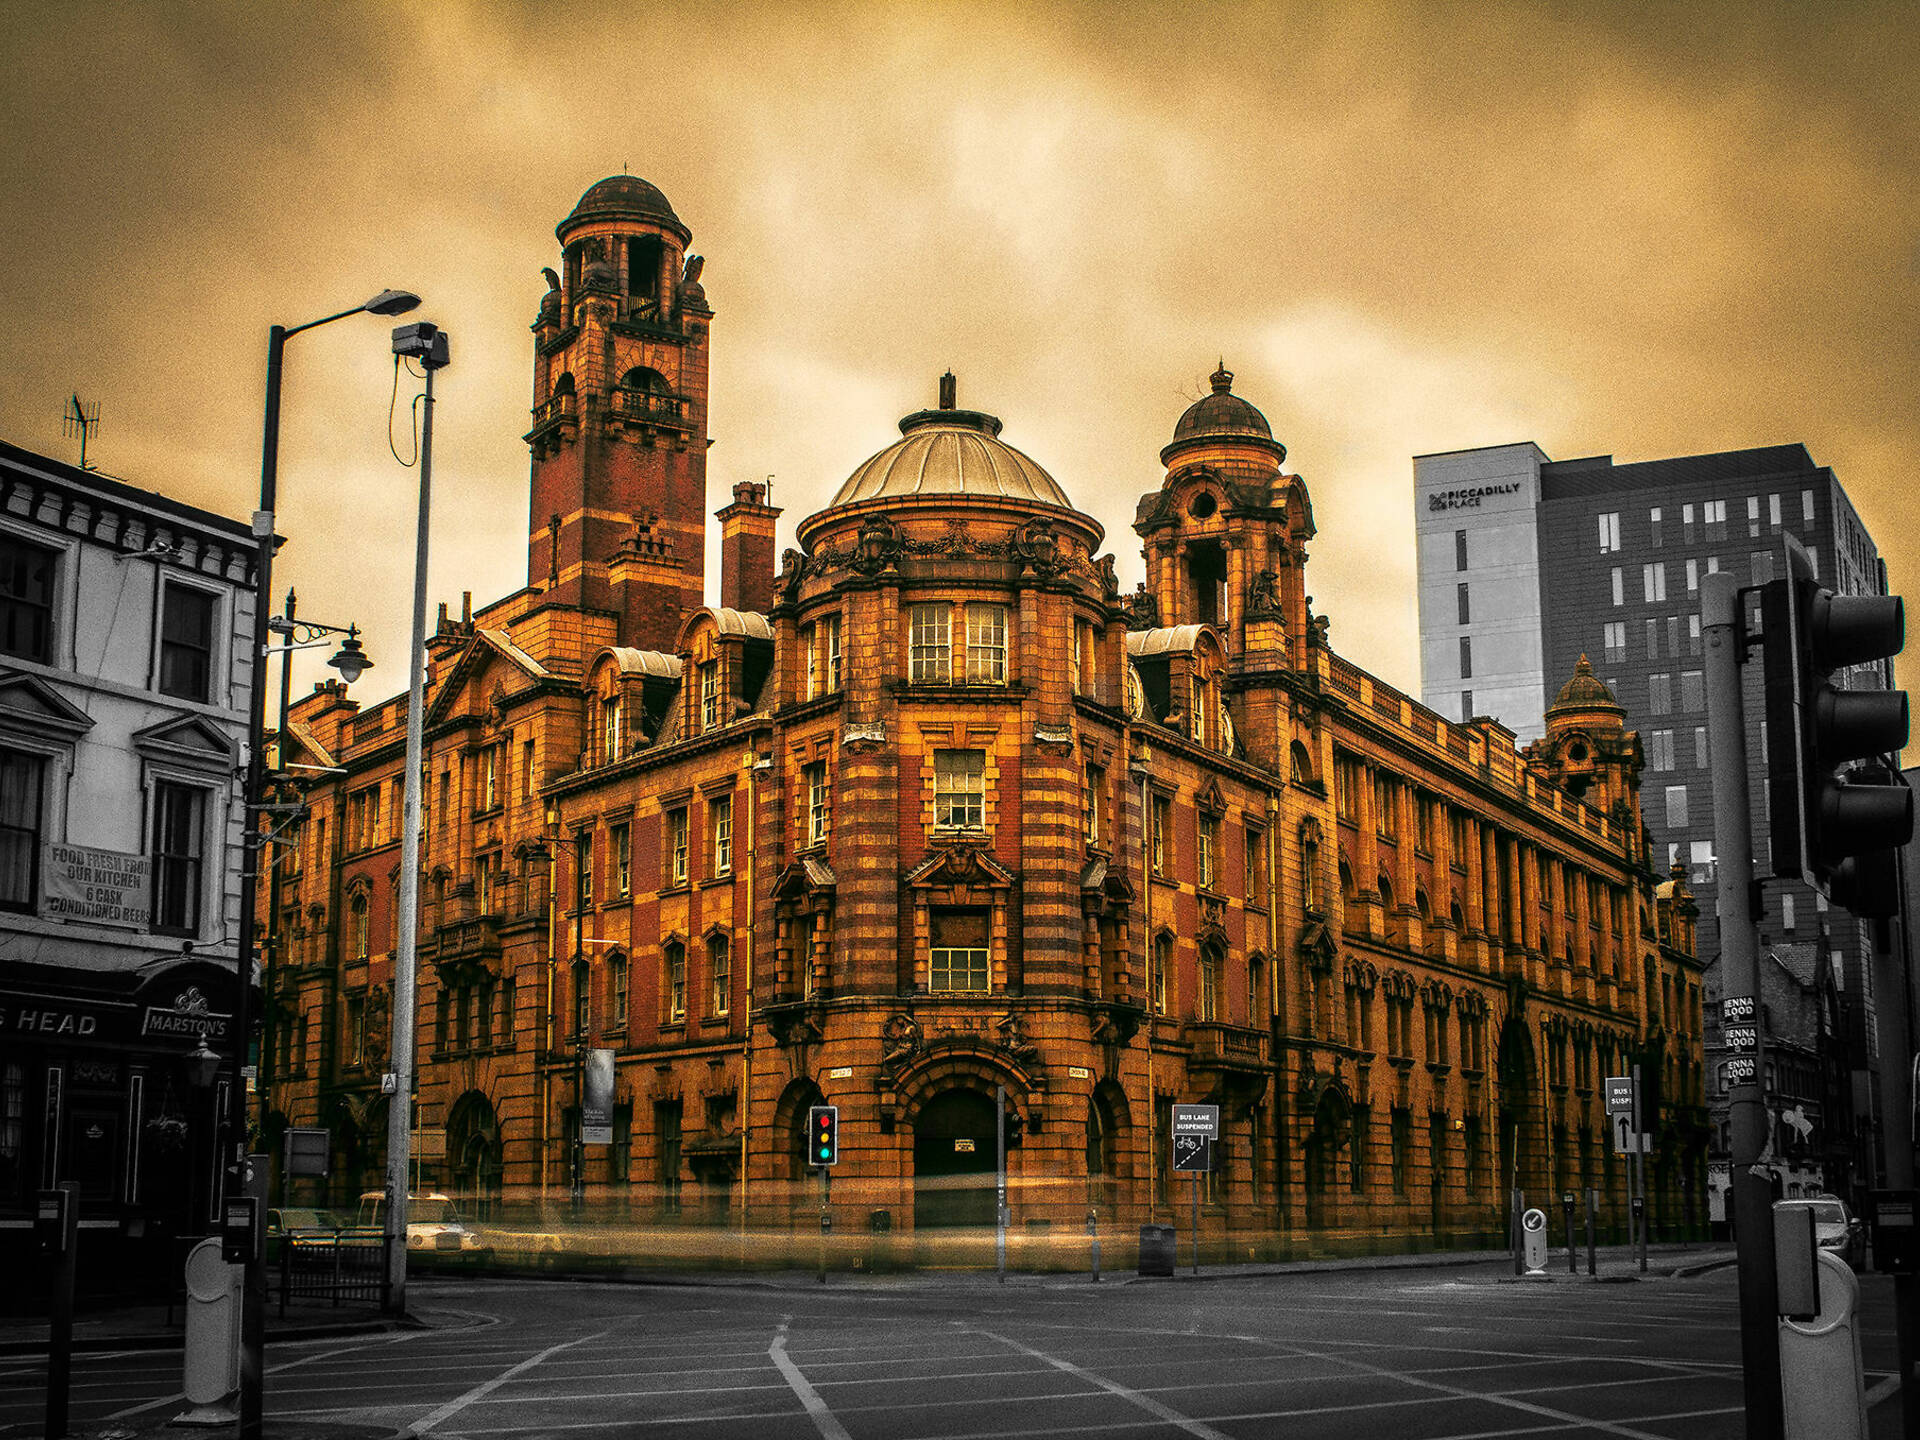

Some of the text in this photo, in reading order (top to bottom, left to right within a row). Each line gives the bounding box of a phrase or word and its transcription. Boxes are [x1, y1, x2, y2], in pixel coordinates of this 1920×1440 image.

[1448, 483, 1520, 499] PICCADILLY
[1448, 497, 1481, 509] PLACE
[52, 847, 85, 866] FOOD
[87, 852, 121, 872] FRESH
[67, 865, 141, 889] OUR KITCHEN
[86, 887, 123, 906] 6 CASK
[50, 897, 121, 920] CONDITIONED
[17, 1009, 97, 1035] HEAD
[149, 1015, 227, 1036] MARSTON'S
